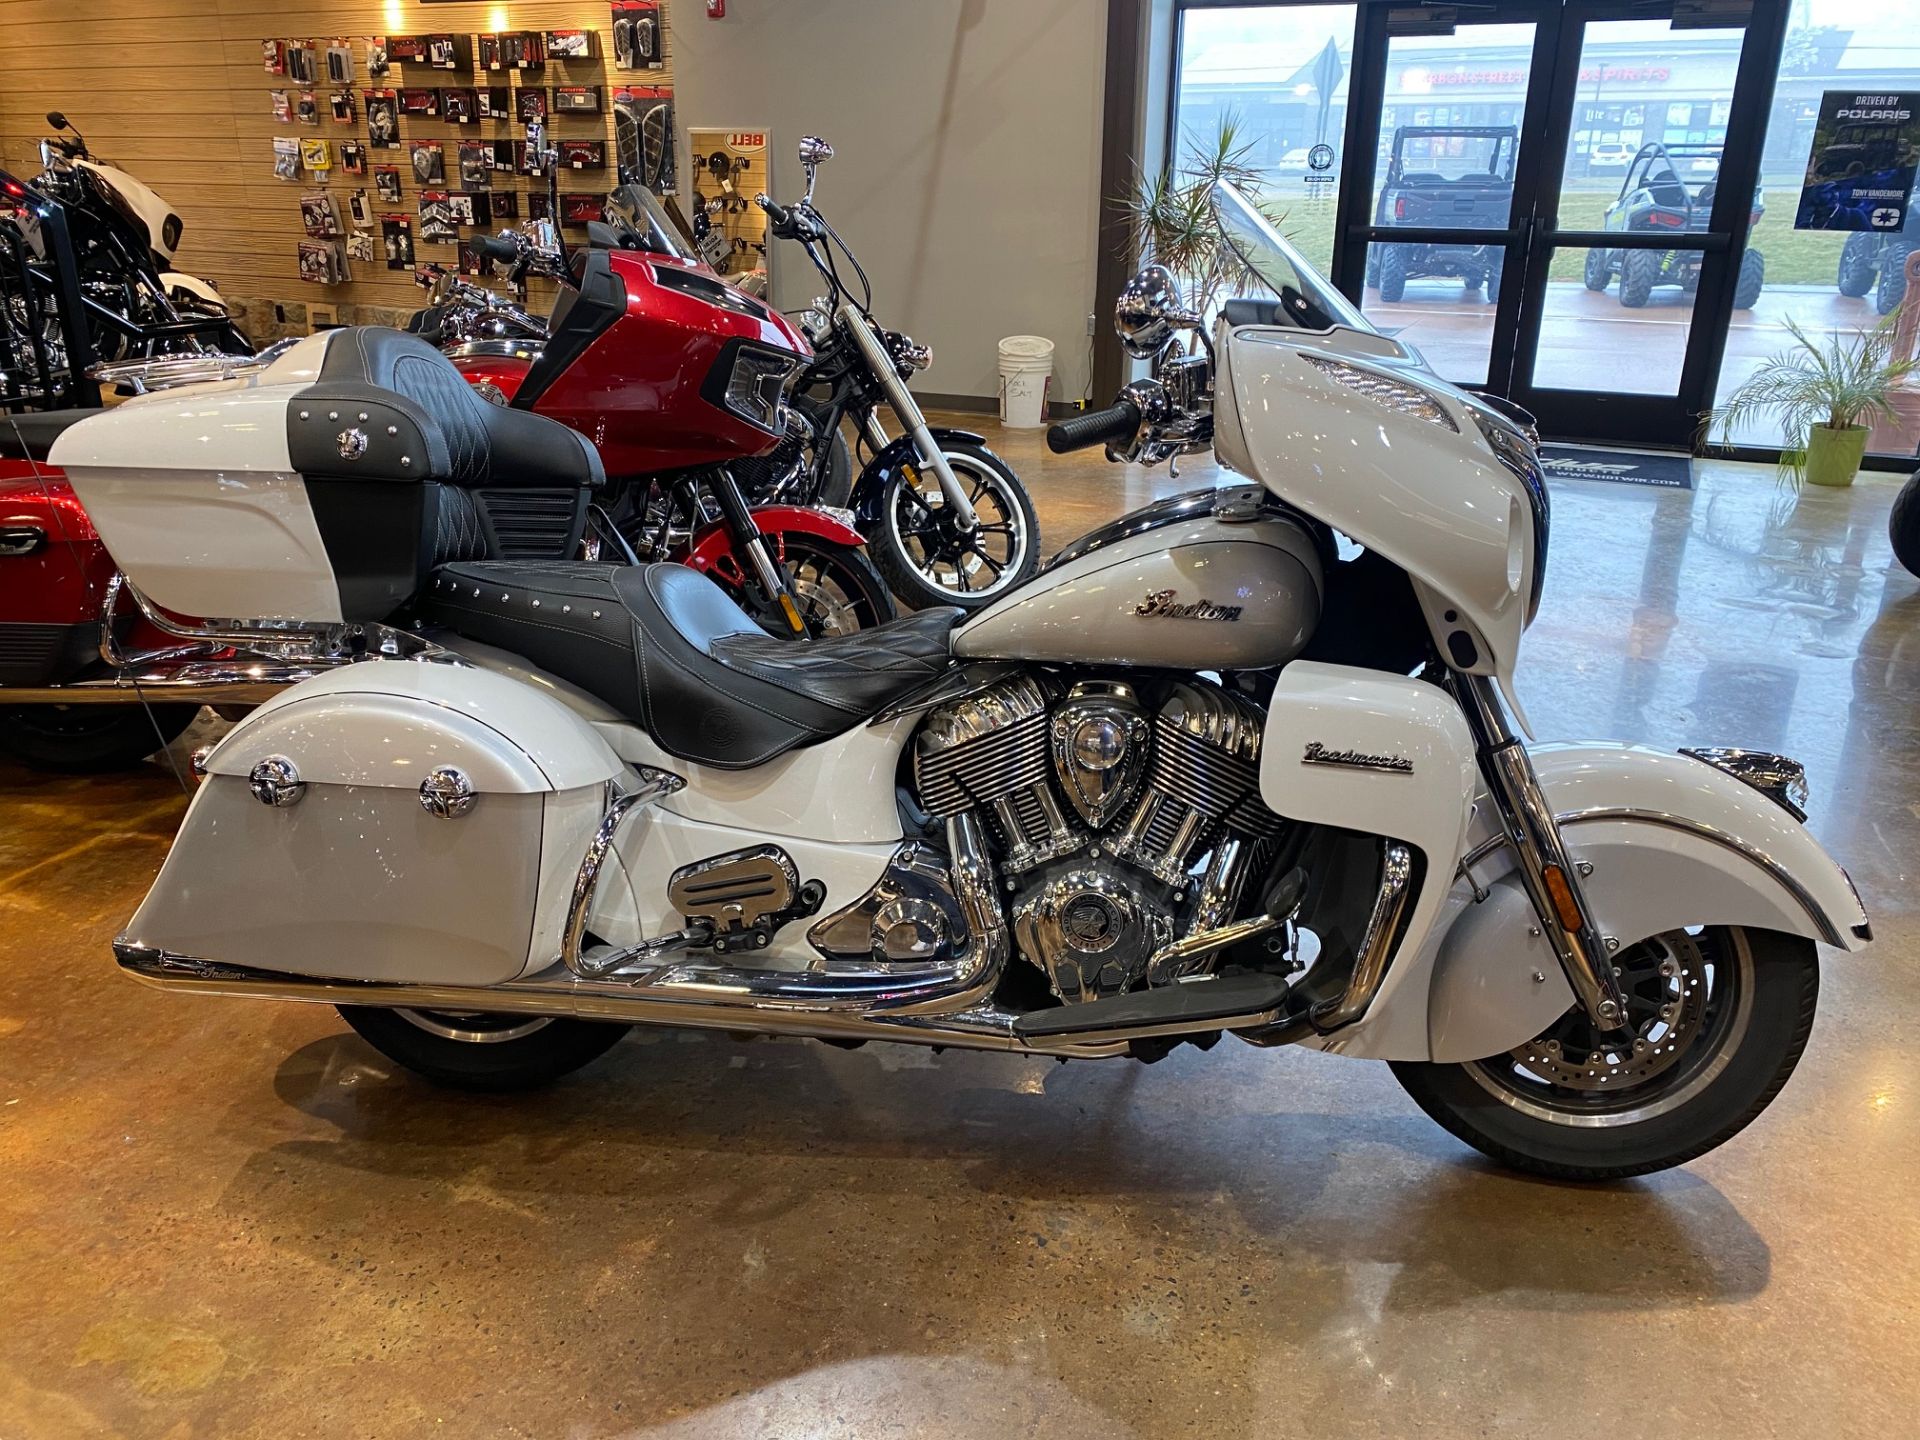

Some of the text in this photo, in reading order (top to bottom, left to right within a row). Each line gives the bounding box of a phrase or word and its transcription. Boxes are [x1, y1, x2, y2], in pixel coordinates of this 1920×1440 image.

[1855, 95, 1899, 106] DRIVEN BY
[1836, 109, 1911, 119] POLARIS
[1134, 588, 1244, 621] Indian
[1302, 741, 1414, 771] Roadmaster
[200, 966, 242, 980] Indian
